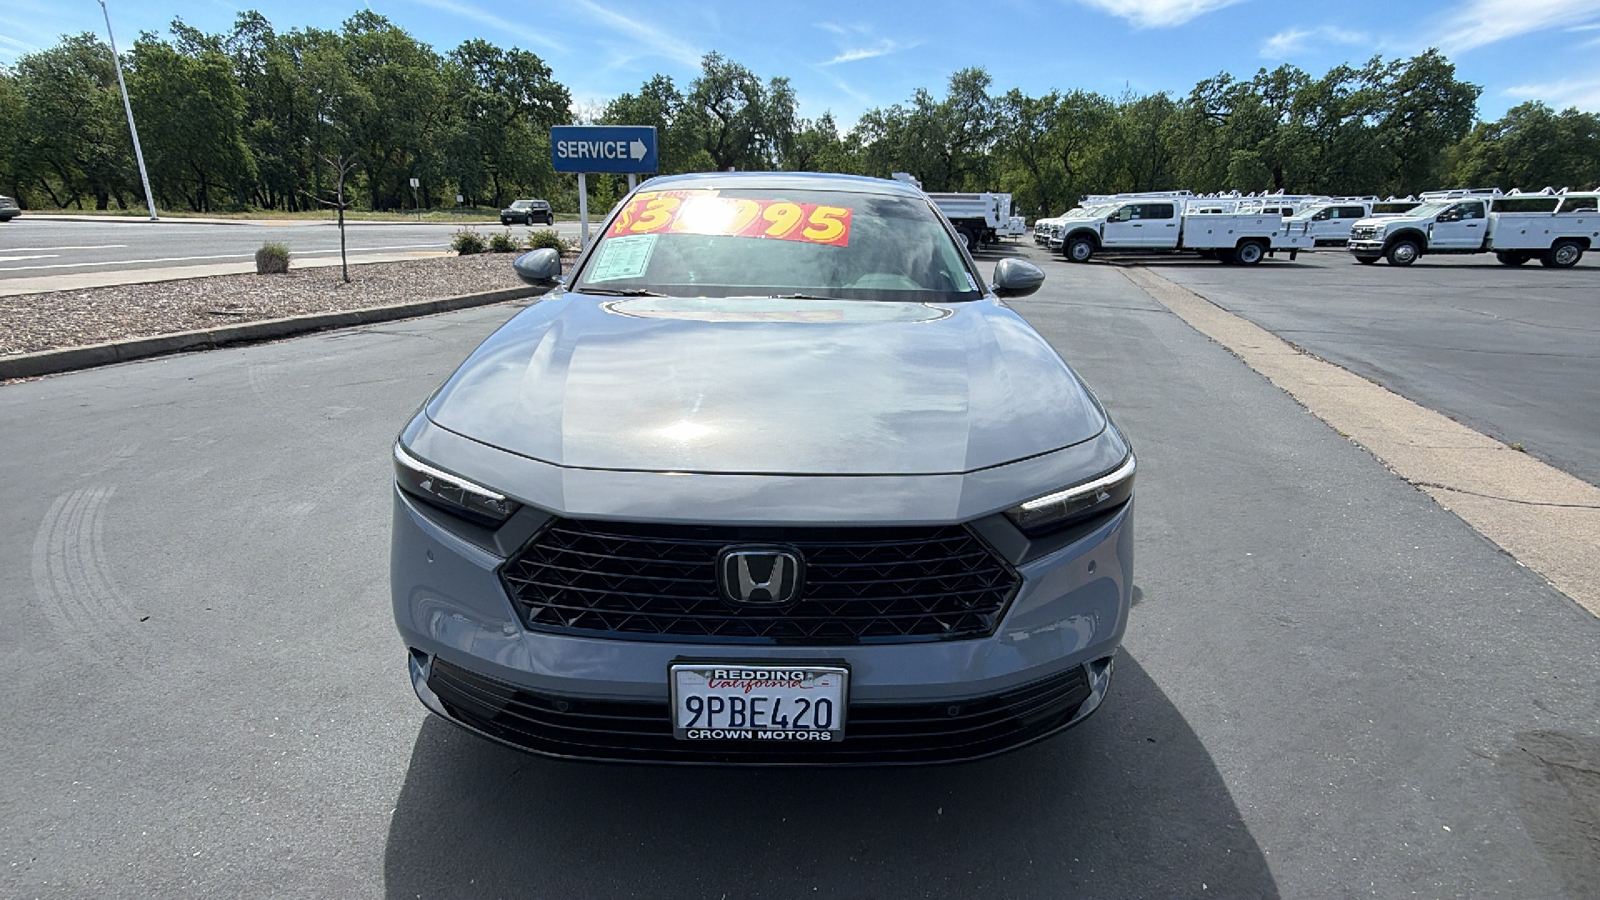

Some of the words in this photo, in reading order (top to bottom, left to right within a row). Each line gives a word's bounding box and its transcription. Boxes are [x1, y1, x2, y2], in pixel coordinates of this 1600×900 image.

[557, 140, 628, 159] SERVICE
[714, 669, 805, 681] REDDING
[685, 695, 833, 729] 9PBE420
[687, 729, 752, 740] CROWN
[757, 730, 832, 741] MOTORS
